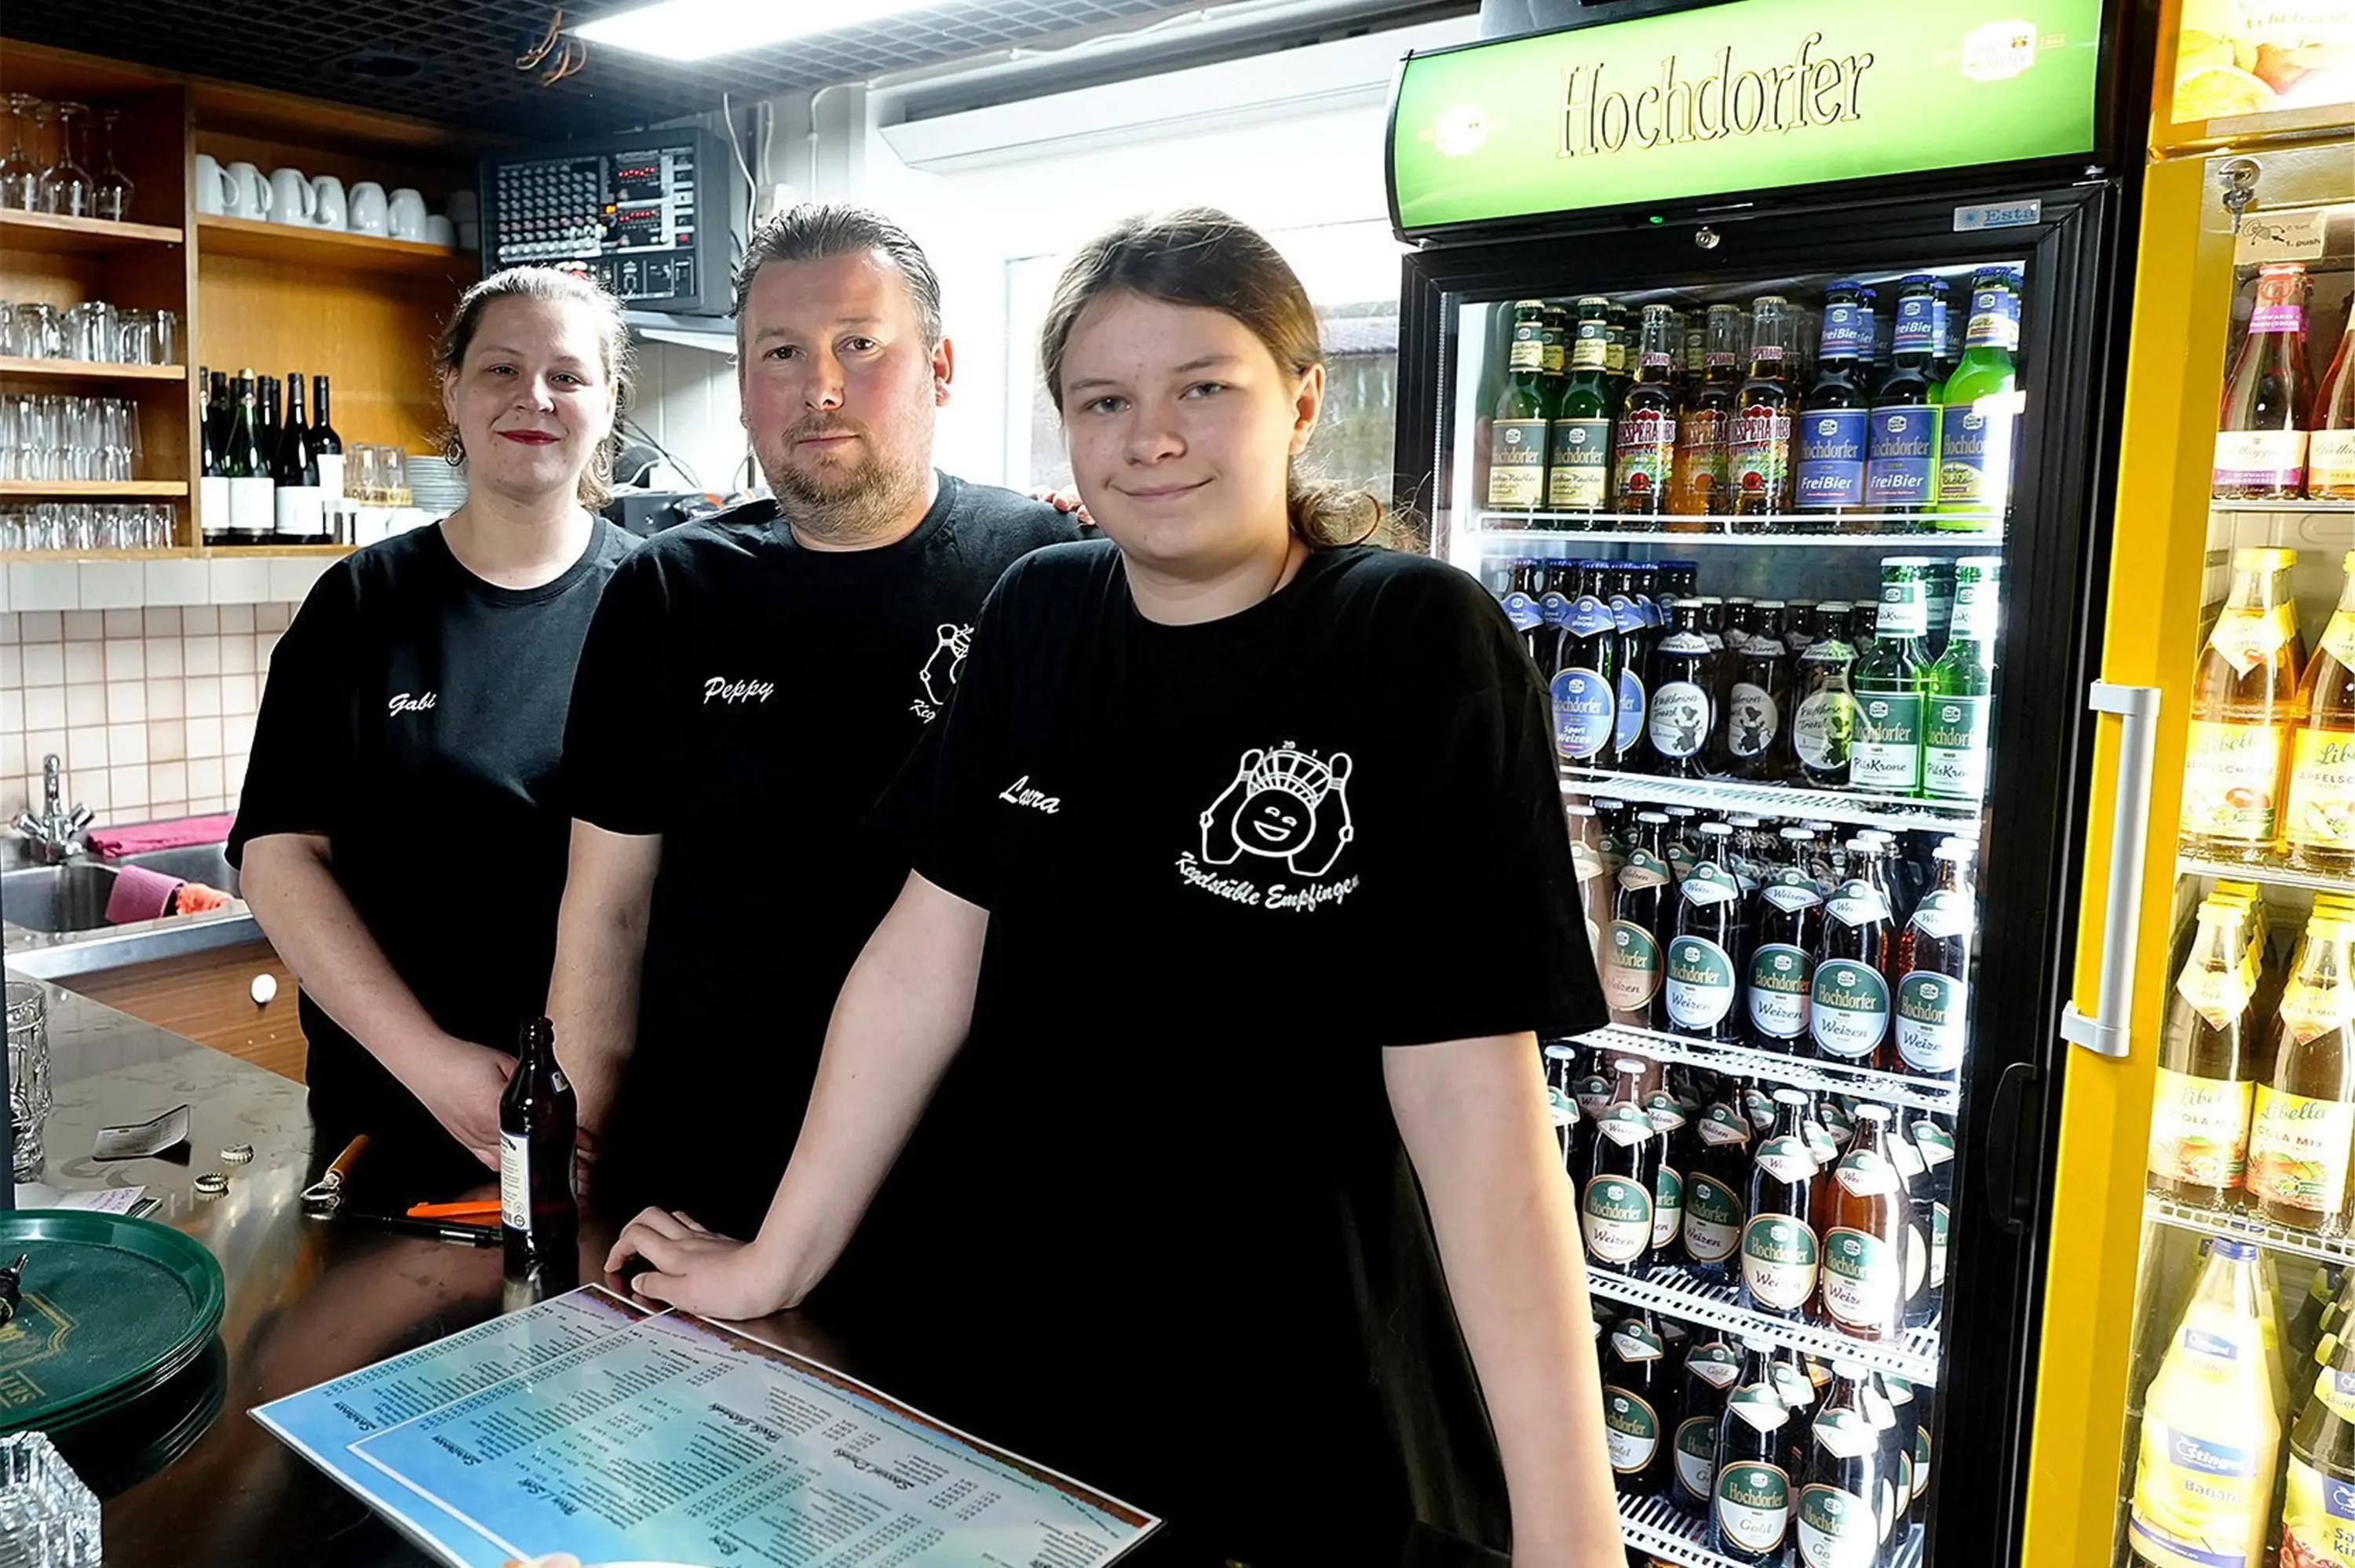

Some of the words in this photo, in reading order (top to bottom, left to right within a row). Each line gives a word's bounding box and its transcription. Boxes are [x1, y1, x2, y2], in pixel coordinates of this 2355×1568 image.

[1556, 31, 1875, 159] Hochdorfer
[1984, 205, 2039, 224] Esta
[1618, 421, 1676, 445] DESPERAOS
[1729, 418, 1791, 445] DESPERAOS
[1944, 435, 1985, 454] Hochdo
[1801, 476, 1853, 489] FreiBier
[1871, 474, 1923, 488] FreiBier
[704, 676, 774, 705] Peppy
[388, 691, 436, 717] Gabi
[1557, 733, 1592, 744] Weizen
[1563, 725, 1586, 737] Sport
[2199, 730, 2258, 753] Libell
[1853, 757, 1907, 772] PilsKrone
[1927, 762, 1967, 778] PilsKro
[999, 775, 1061, 814] Laura
[1175, 851, 1261, 905] Kegelstüble
[1265, 874, 1360, 912] Empfingen
[1685, 882, 1714, 894] Weiz
[1772, 888, 1806, 902] Weizen
[1670, 960, 1720, 984] Hochdorfer
[1755, 968, 1809, 992] Hochdorfer
[1672, 993, 1711, 1011] Weizen
[1819, 983, 1876, 1010] Hochdorfer
[1758, 1001, 1802, 1019] Weizen
[1902, 996, 1949, 1022] Hochdorf
[1821, 1018, 1868, 1037] Weizen
[1904, 1032, 1943, 1051] Weize
[2261, 1102, 2325, 1121] Libella
[2258, 1125, 2291, 1142] COLA
[2296, 1136, 2323, 1147] MIX
[1591, 1195, 1641, 1220] Hochdorfer
[1594, 1227, 1635, 1245] Weizen
[1686, 1225, 1722, 1248] Weizen
[1827, 1249, 1868, 1278] Hochdor
[1755, 1269, 1801, 1289] Wein
[1829, 1283, 1861, 1304] Weiz
[1609, 1413, 1645, 1436] chdorfer
[1729, 1482, 1784, 1508] Hochdorfer
[2185, 1480, 2245, 1503] Banan
[1739, 1517, 1773, 1535] Gold
[1806, 1504, 1841, 1533] Hochdo
